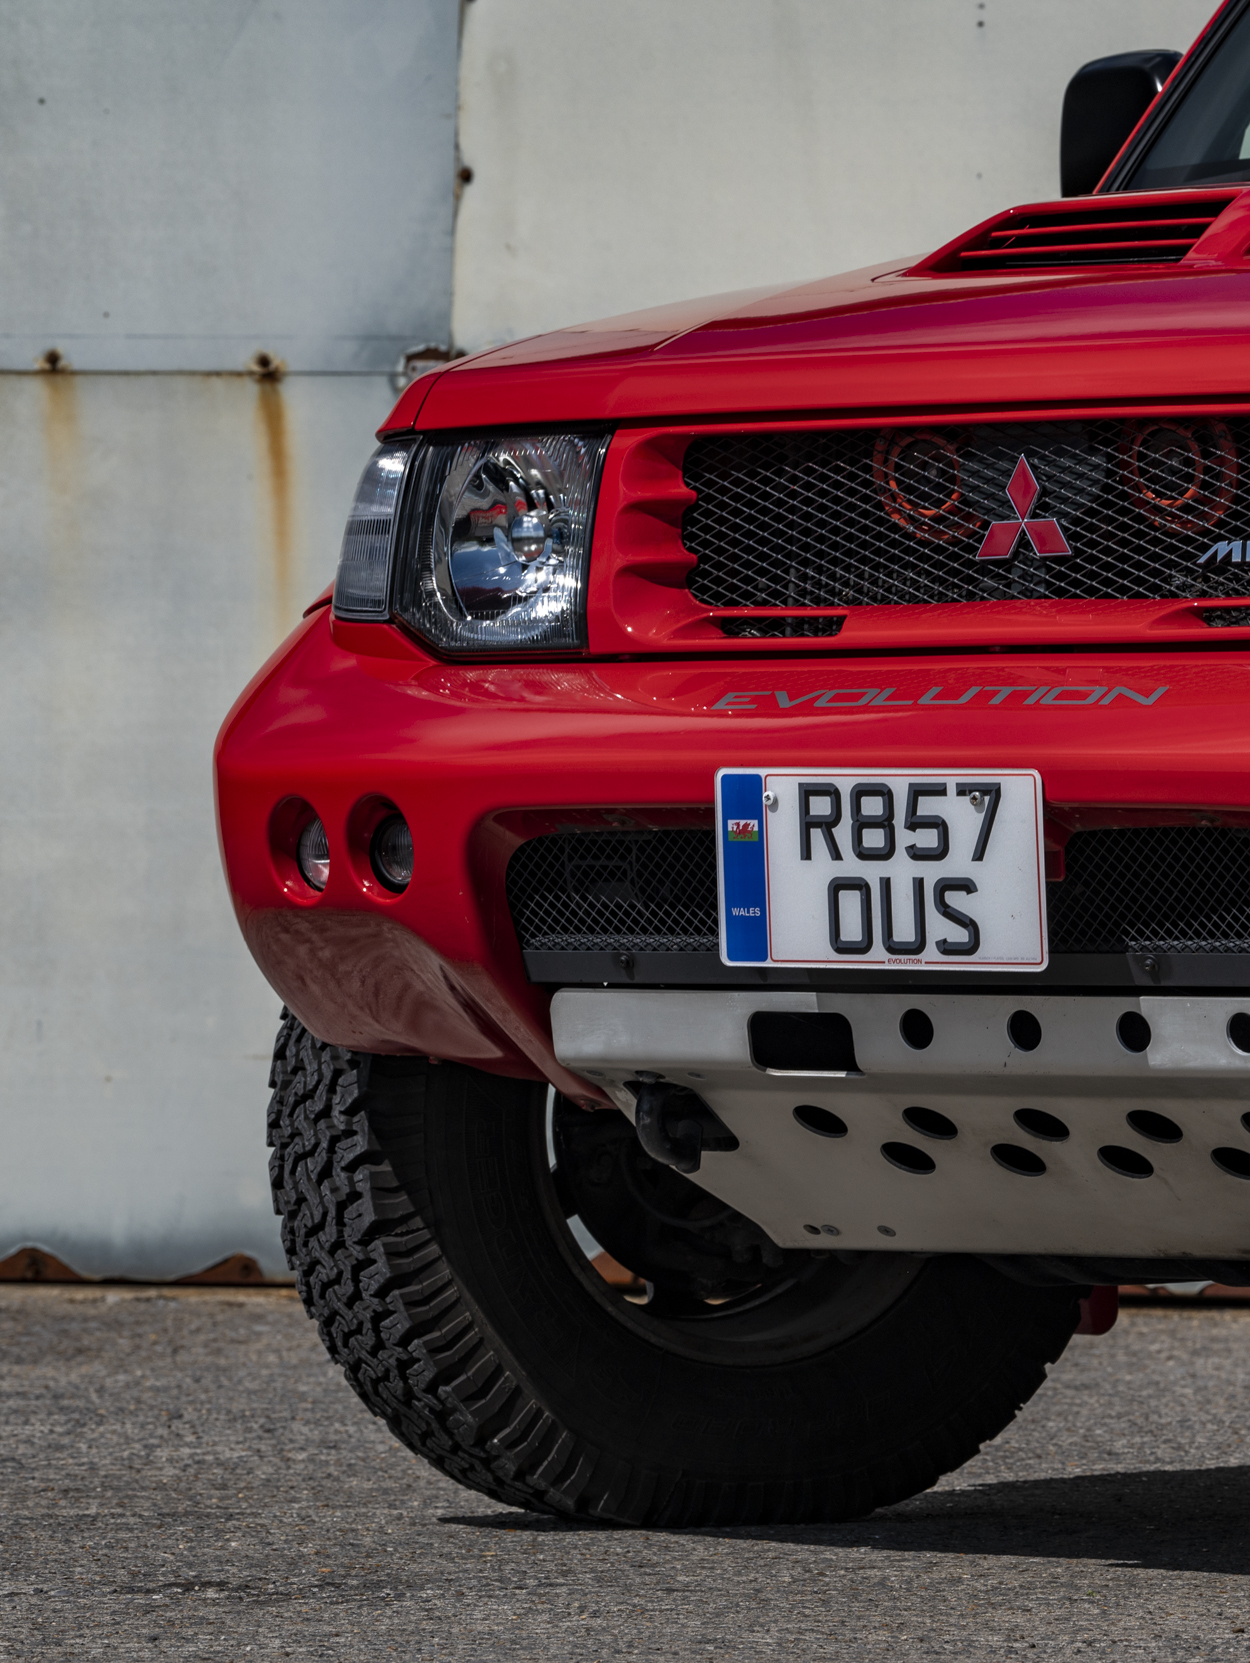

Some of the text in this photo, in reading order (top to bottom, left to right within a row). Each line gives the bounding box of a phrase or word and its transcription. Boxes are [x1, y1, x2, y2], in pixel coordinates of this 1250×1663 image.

[710, 686, 1169, 710] EVOLUTION
[797, 782, 1002, 862] R857
[731, 907, 761, 917] WALES
[827, 876, 981, 956] OUS
[887, 957, 923, 965] EVOLUTION
